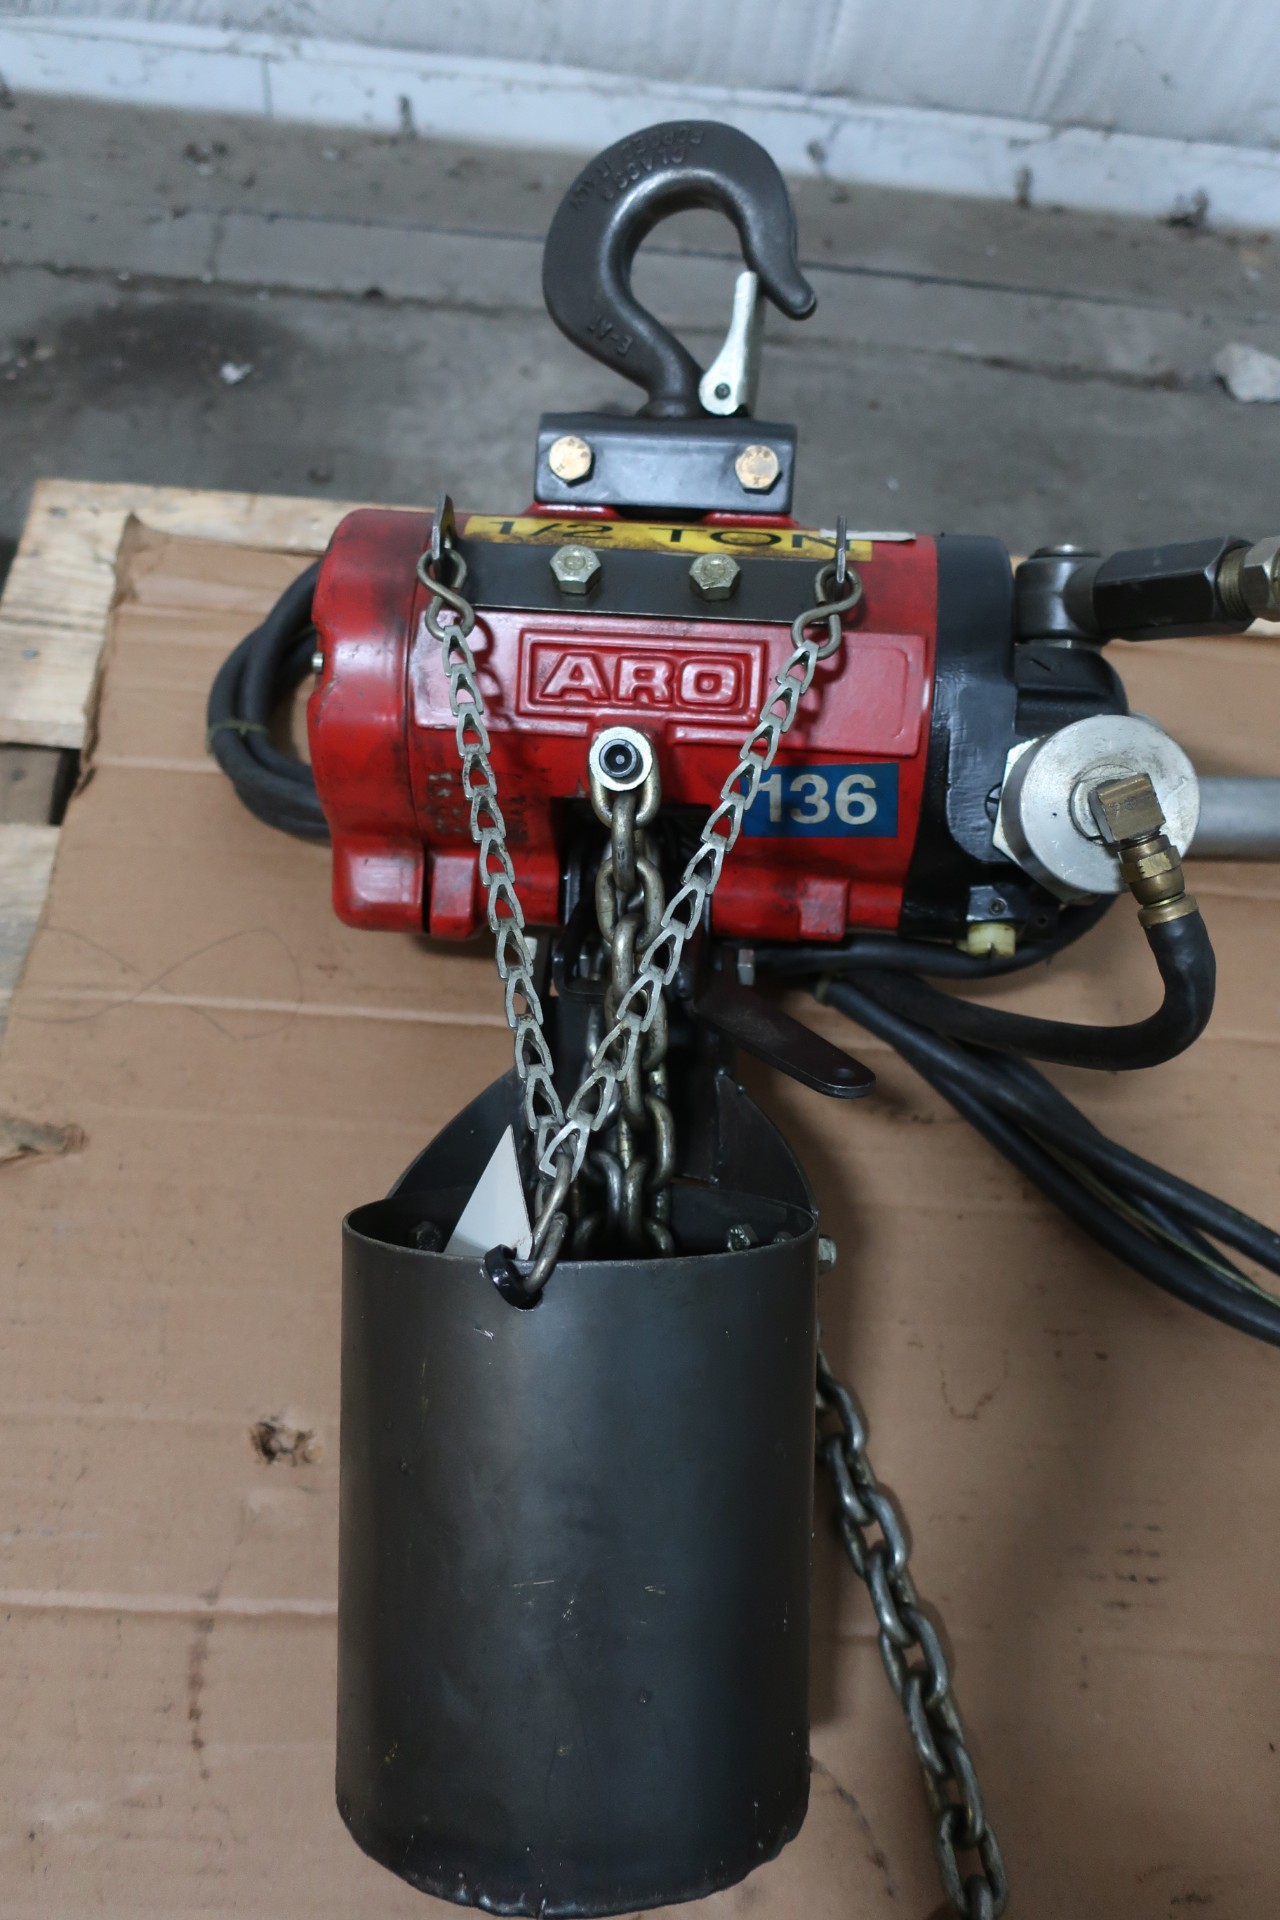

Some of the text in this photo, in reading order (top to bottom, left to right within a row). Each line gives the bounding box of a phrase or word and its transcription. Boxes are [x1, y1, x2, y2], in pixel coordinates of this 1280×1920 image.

[489, 520, 853, 550] 1/2 TON
[540, 653, 737, 707] ARO
[752, 774, 879, 826] 136
